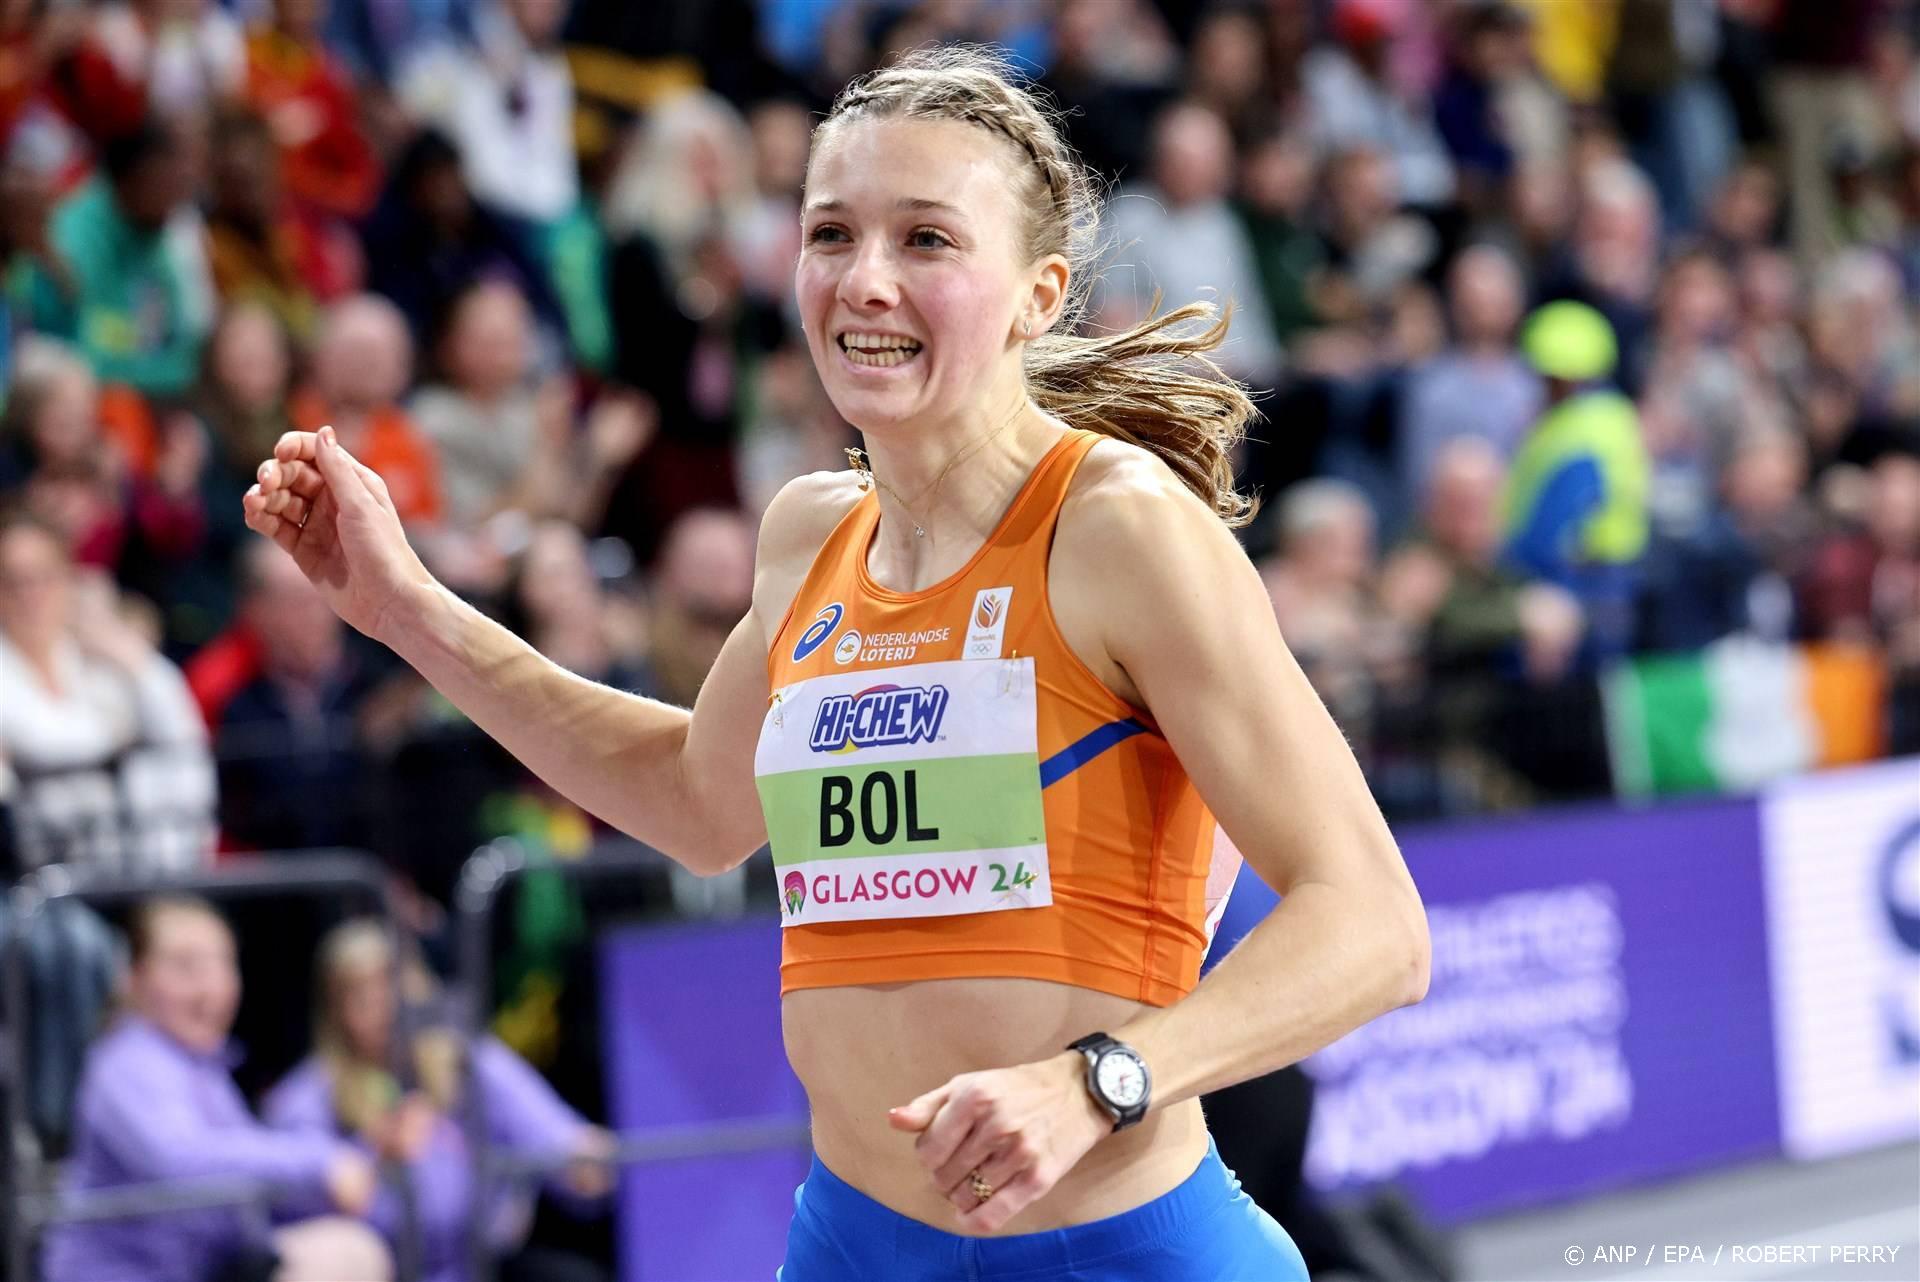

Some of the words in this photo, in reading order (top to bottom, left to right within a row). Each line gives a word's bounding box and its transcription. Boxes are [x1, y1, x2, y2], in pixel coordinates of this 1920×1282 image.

[860, 646, 916, 662] LOTERIJ
[864, 628, 950, 647] NEDERLANDSE
[809, 685, 949, 753] HI-CHEW
[820, 769, 940, 848] BOL
[812, 865, 978, 905] GLASGOW
[988, 861, 1034, 892] 24
